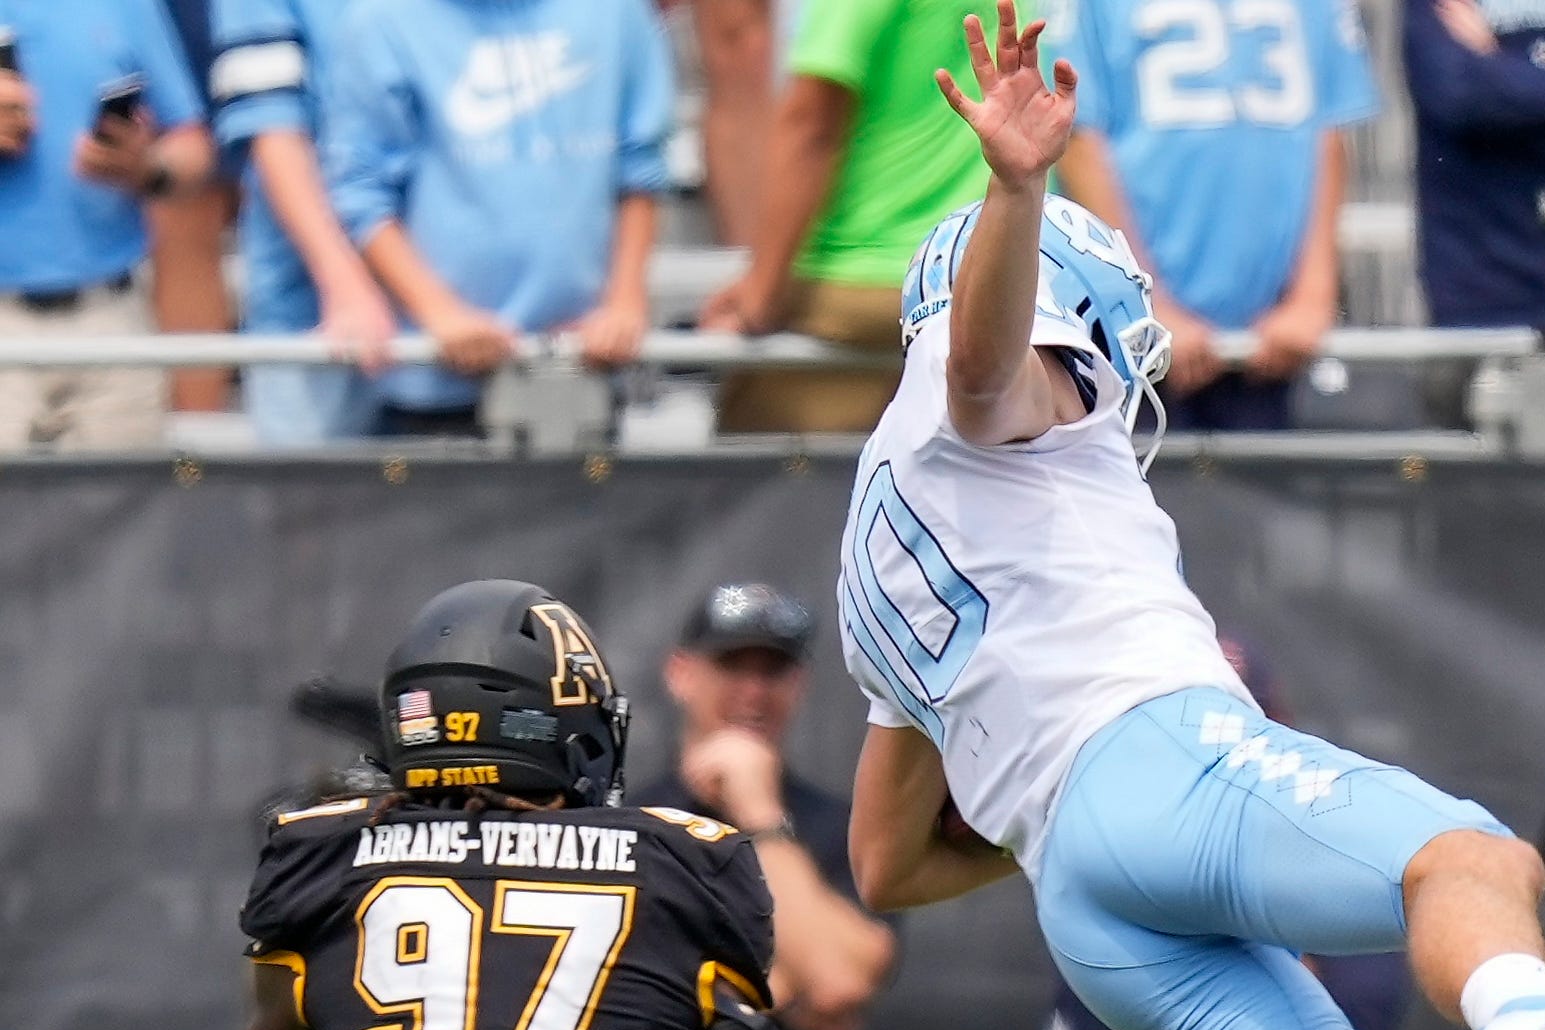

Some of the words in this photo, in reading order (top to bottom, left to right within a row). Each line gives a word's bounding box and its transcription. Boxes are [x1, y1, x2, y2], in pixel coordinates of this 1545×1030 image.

[1134, 0, 1315, 124] 23
[445, 711, 481, 742] 97
[440, 765, 500, 787] STATE
